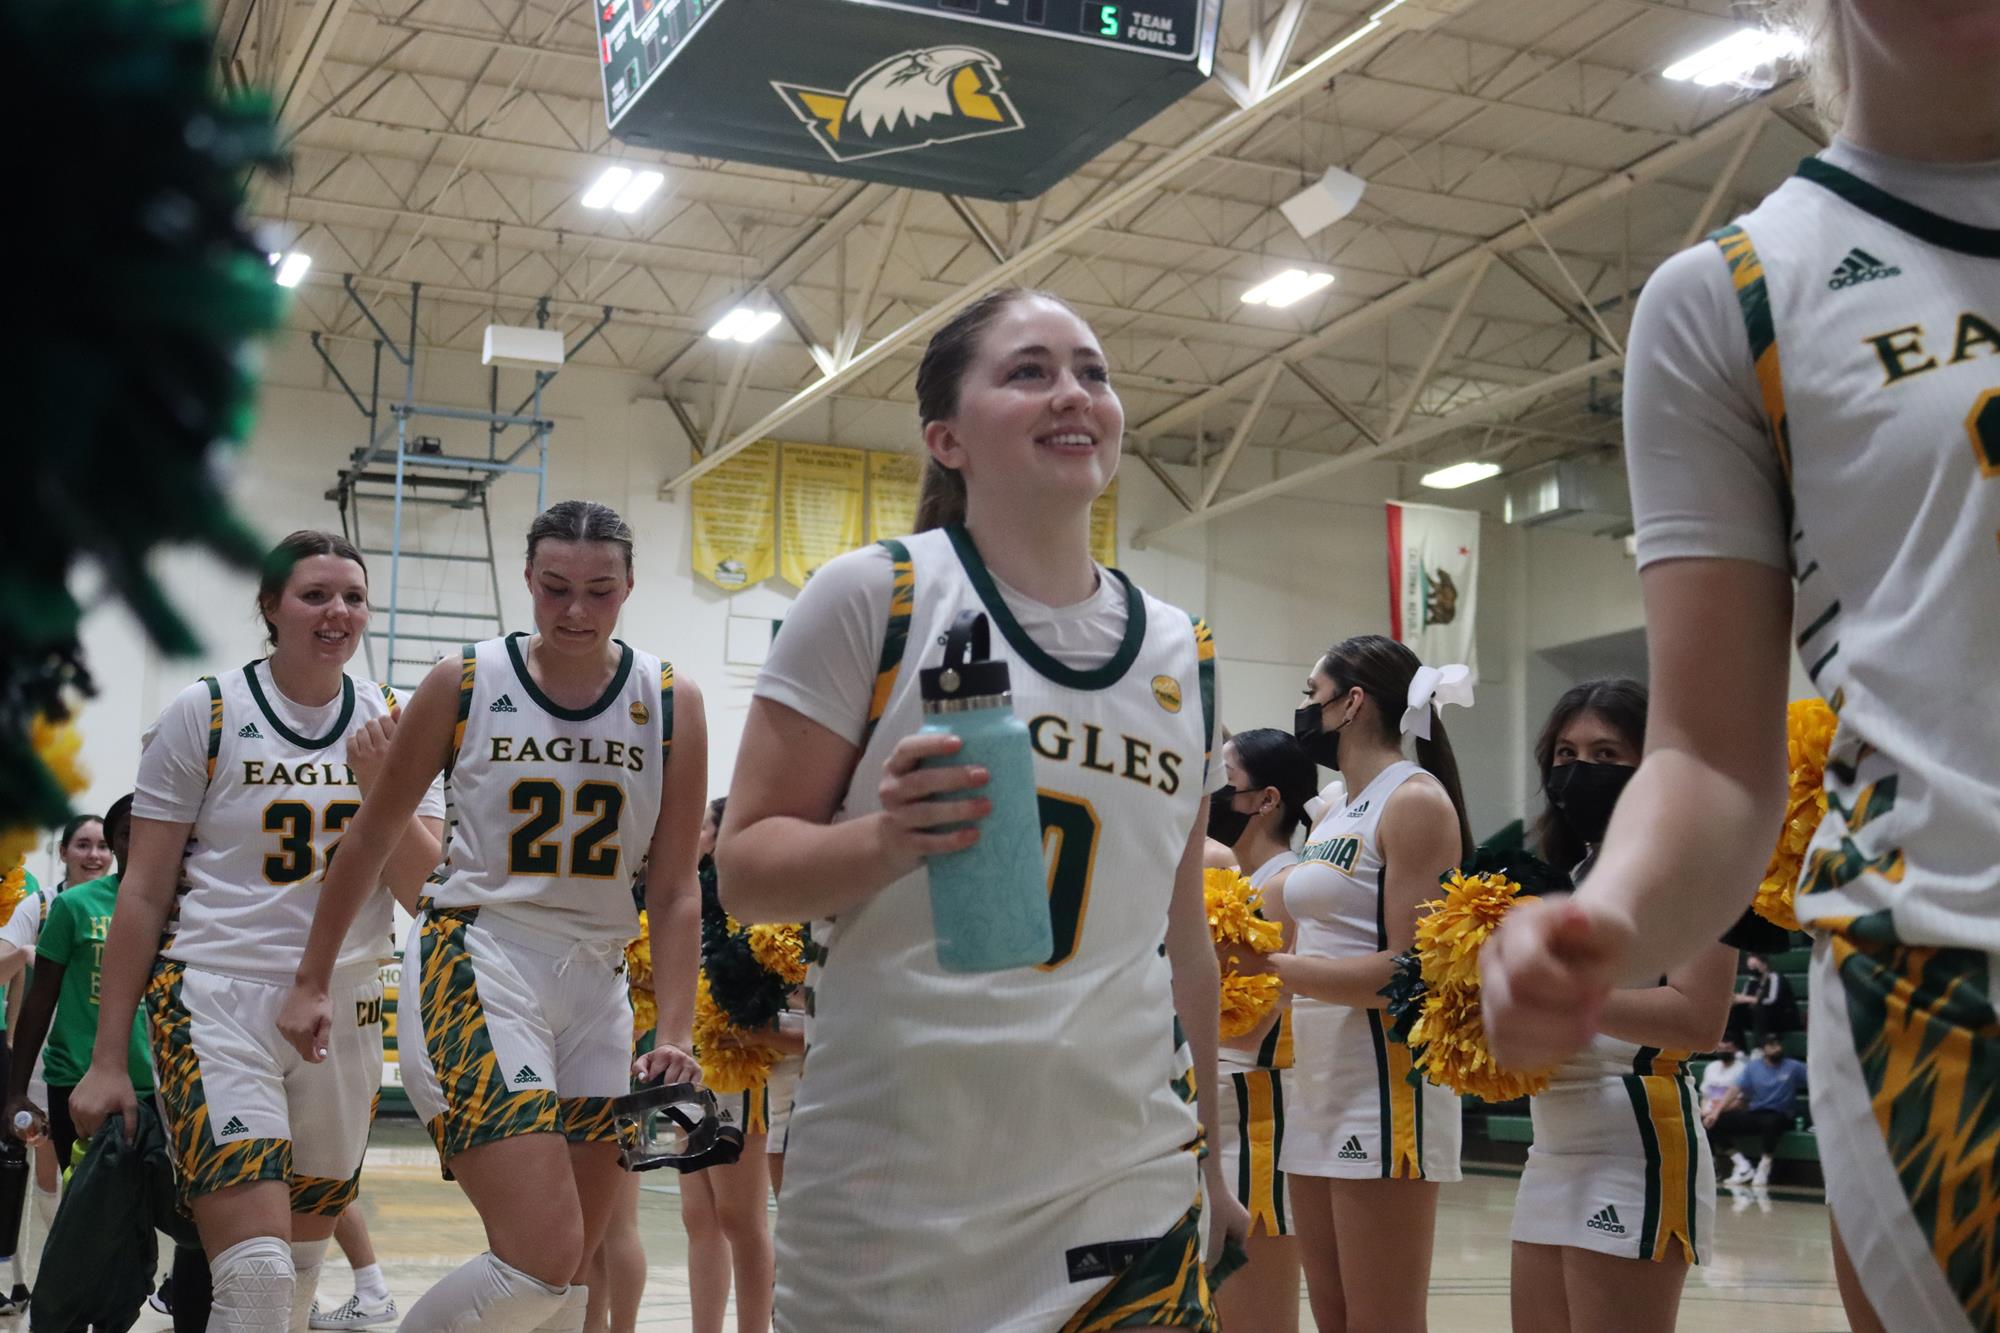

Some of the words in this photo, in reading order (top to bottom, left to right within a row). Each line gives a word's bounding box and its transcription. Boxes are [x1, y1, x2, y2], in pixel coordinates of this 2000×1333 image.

[1101, 6, 1118, 35] 5
[1132, 11, 1173, 31] TEAM
[1128, 26, 1176, 46] FOULS
[1828, 265, 1902, 291] adidas
[490, 704, 517, 713] adidas
[238, 731, 264, 740] adidas
[489, 736, 645, 773] EAGLES
[508, 777, 626, 881] 22
[221, 1126, 249, 1136] adidas
[1338, 1150, 1368, 1159] adidas
[1587, 1219, 1626, 1234] adidas
